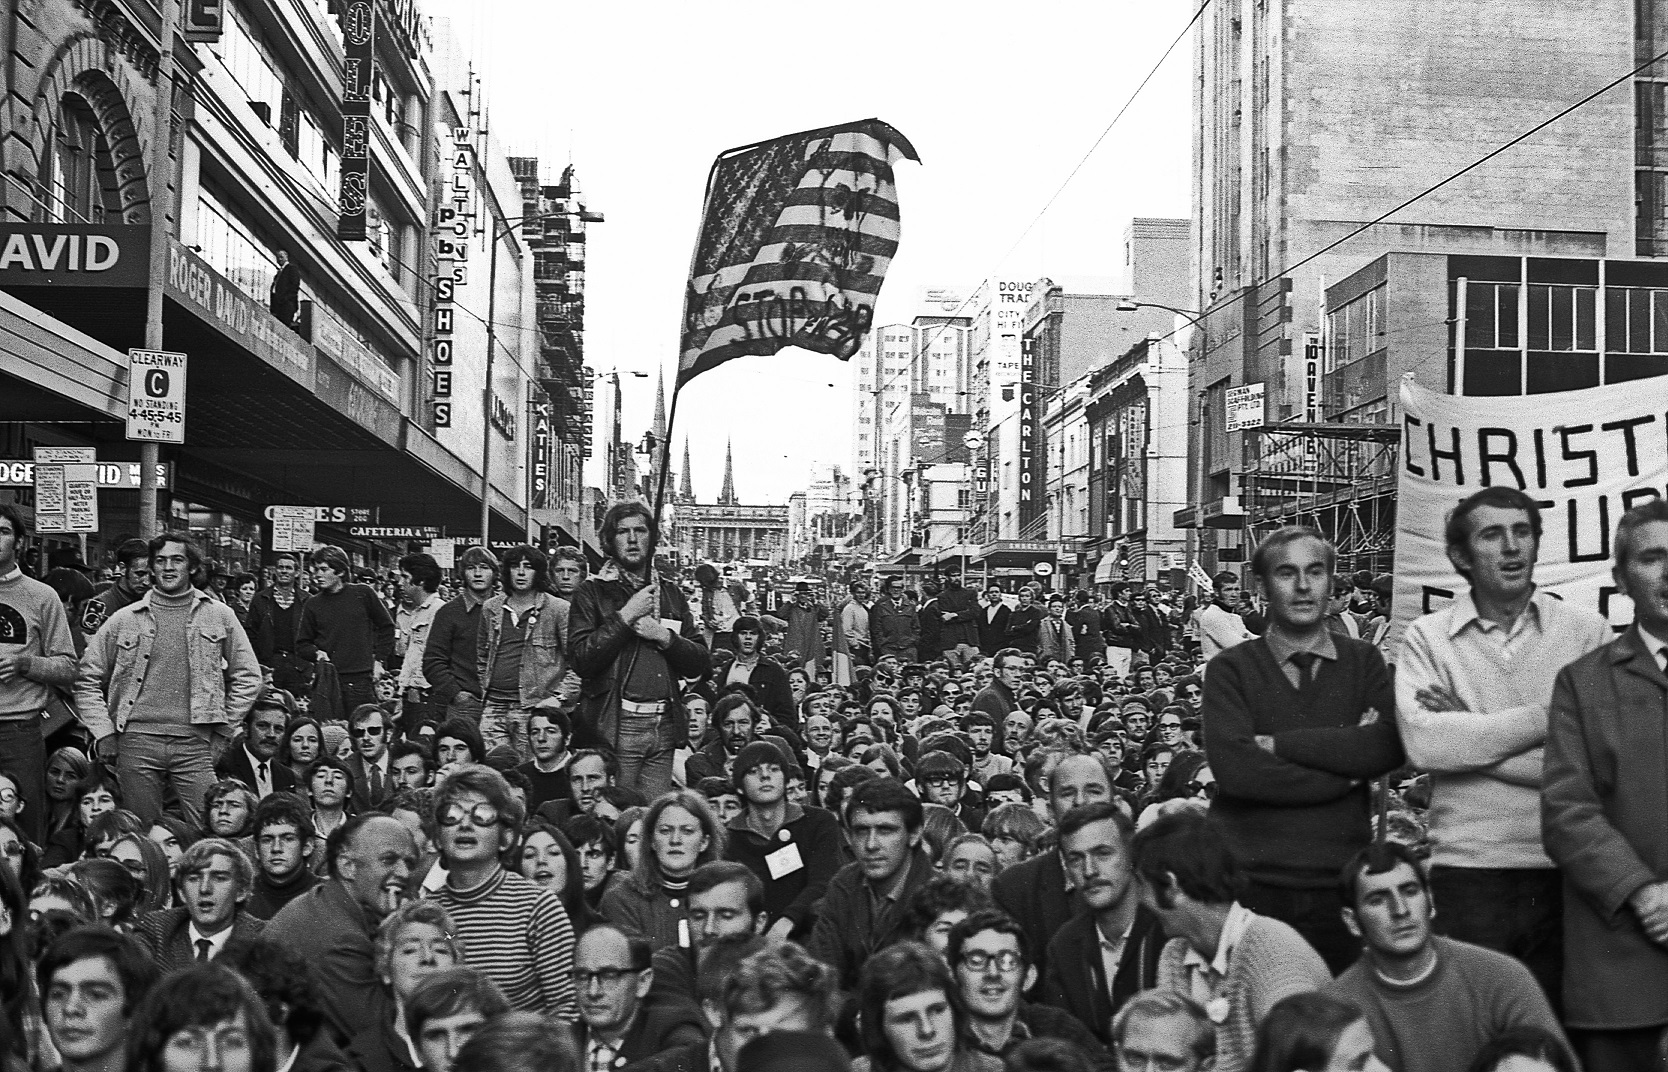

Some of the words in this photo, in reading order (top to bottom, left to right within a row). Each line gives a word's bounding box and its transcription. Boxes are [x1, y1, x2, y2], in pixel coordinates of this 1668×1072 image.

[453, 129, 470, 283] WALTONS
[0, 234, 119, 271] AVID
[170, 247, 211, 311] ROGER
[131, 352, 183, 367] CLEARWAY
[436, 278, 452, 424] SHOES
[1023, 339, 1036, 383] THE
[151, 372, 164, 394] C
[535, 403, 548, 490] KATIES
[1021, 392, 1032, 501] CARLTON
[1405, 412, 1668, 490] CHRIST
[264, 505, 346, 523] CES
[350, 527, 414, 537] CAFETERIA
